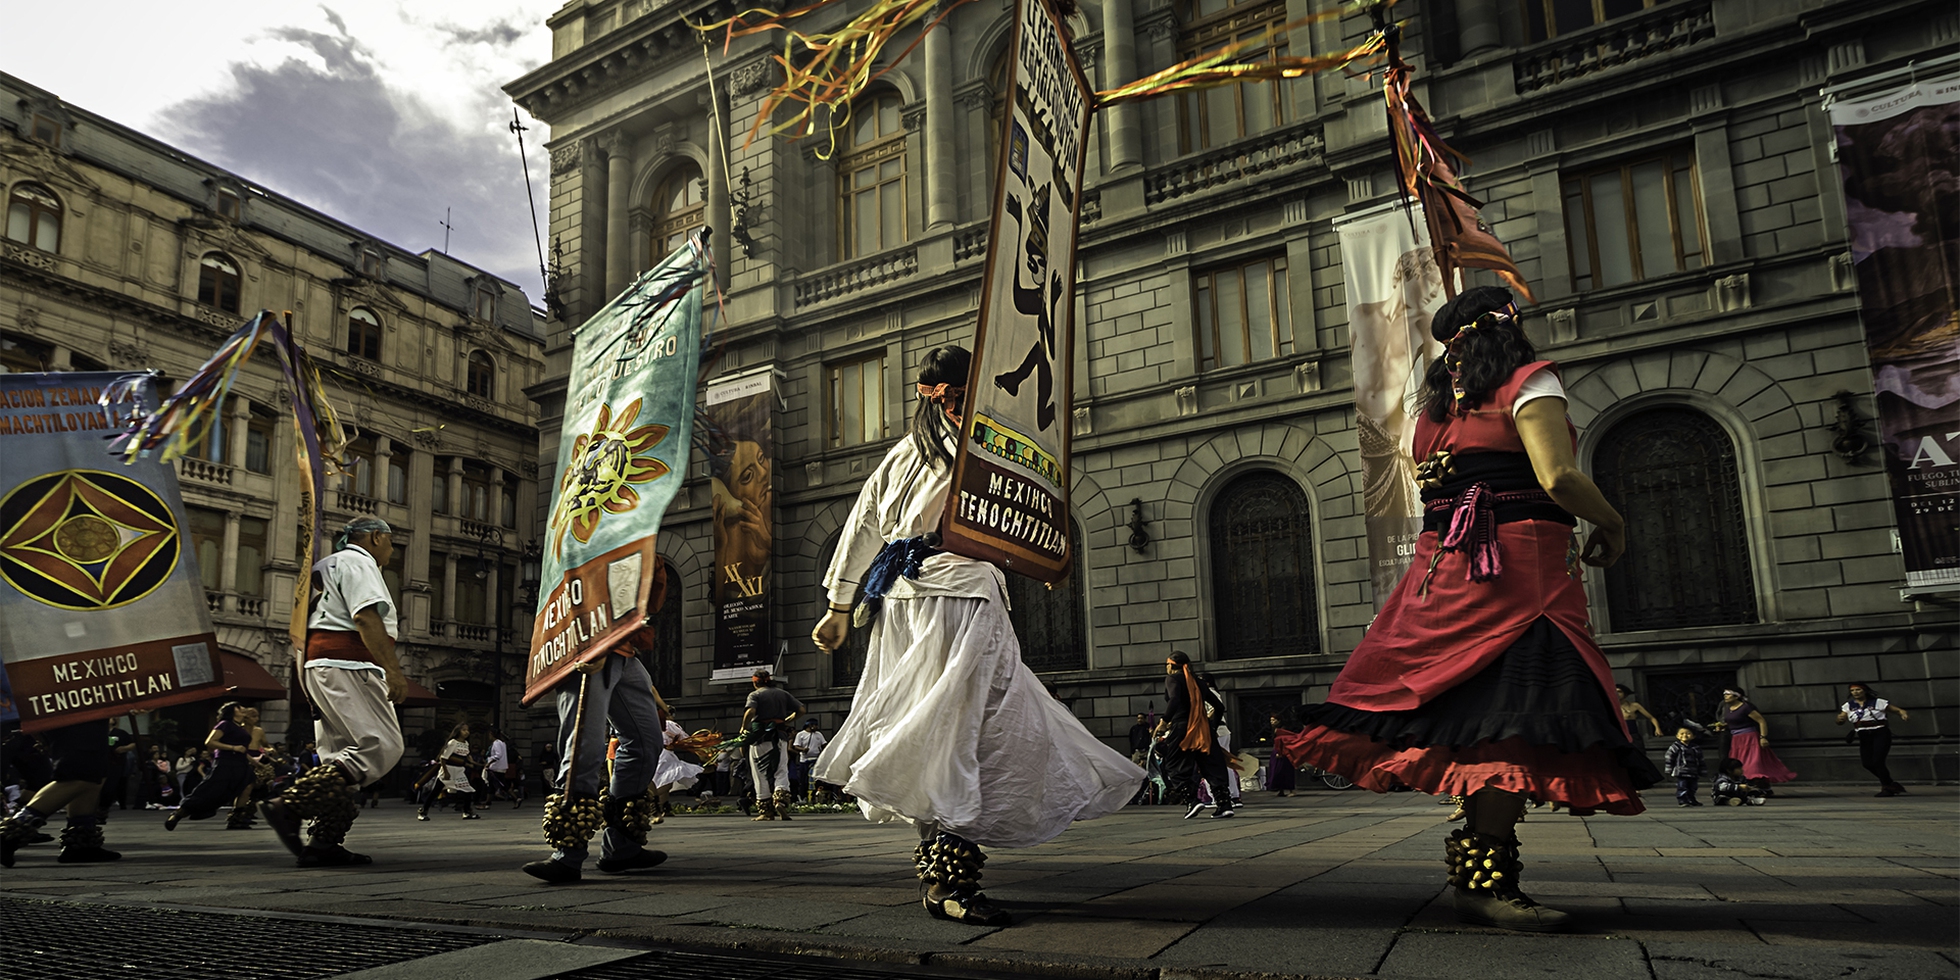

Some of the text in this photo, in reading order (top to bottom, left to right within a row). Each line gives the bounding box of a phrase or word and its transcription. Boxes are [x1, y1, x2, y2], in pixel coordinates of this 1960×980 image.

[1871, 90, 1922, 112] CULTURA
[0, 387, 45, 409] ACION
[0, 411, 109, 435] MACHTILOYAN
[988, 472, 1053, 519] MEXIHCO
[959, 489, 1067, 557] TENOCHTITLAN
[52, 652, 138, 684] MEXIHCO
[28, 673, 173, 716] TENOCHTITLAN
